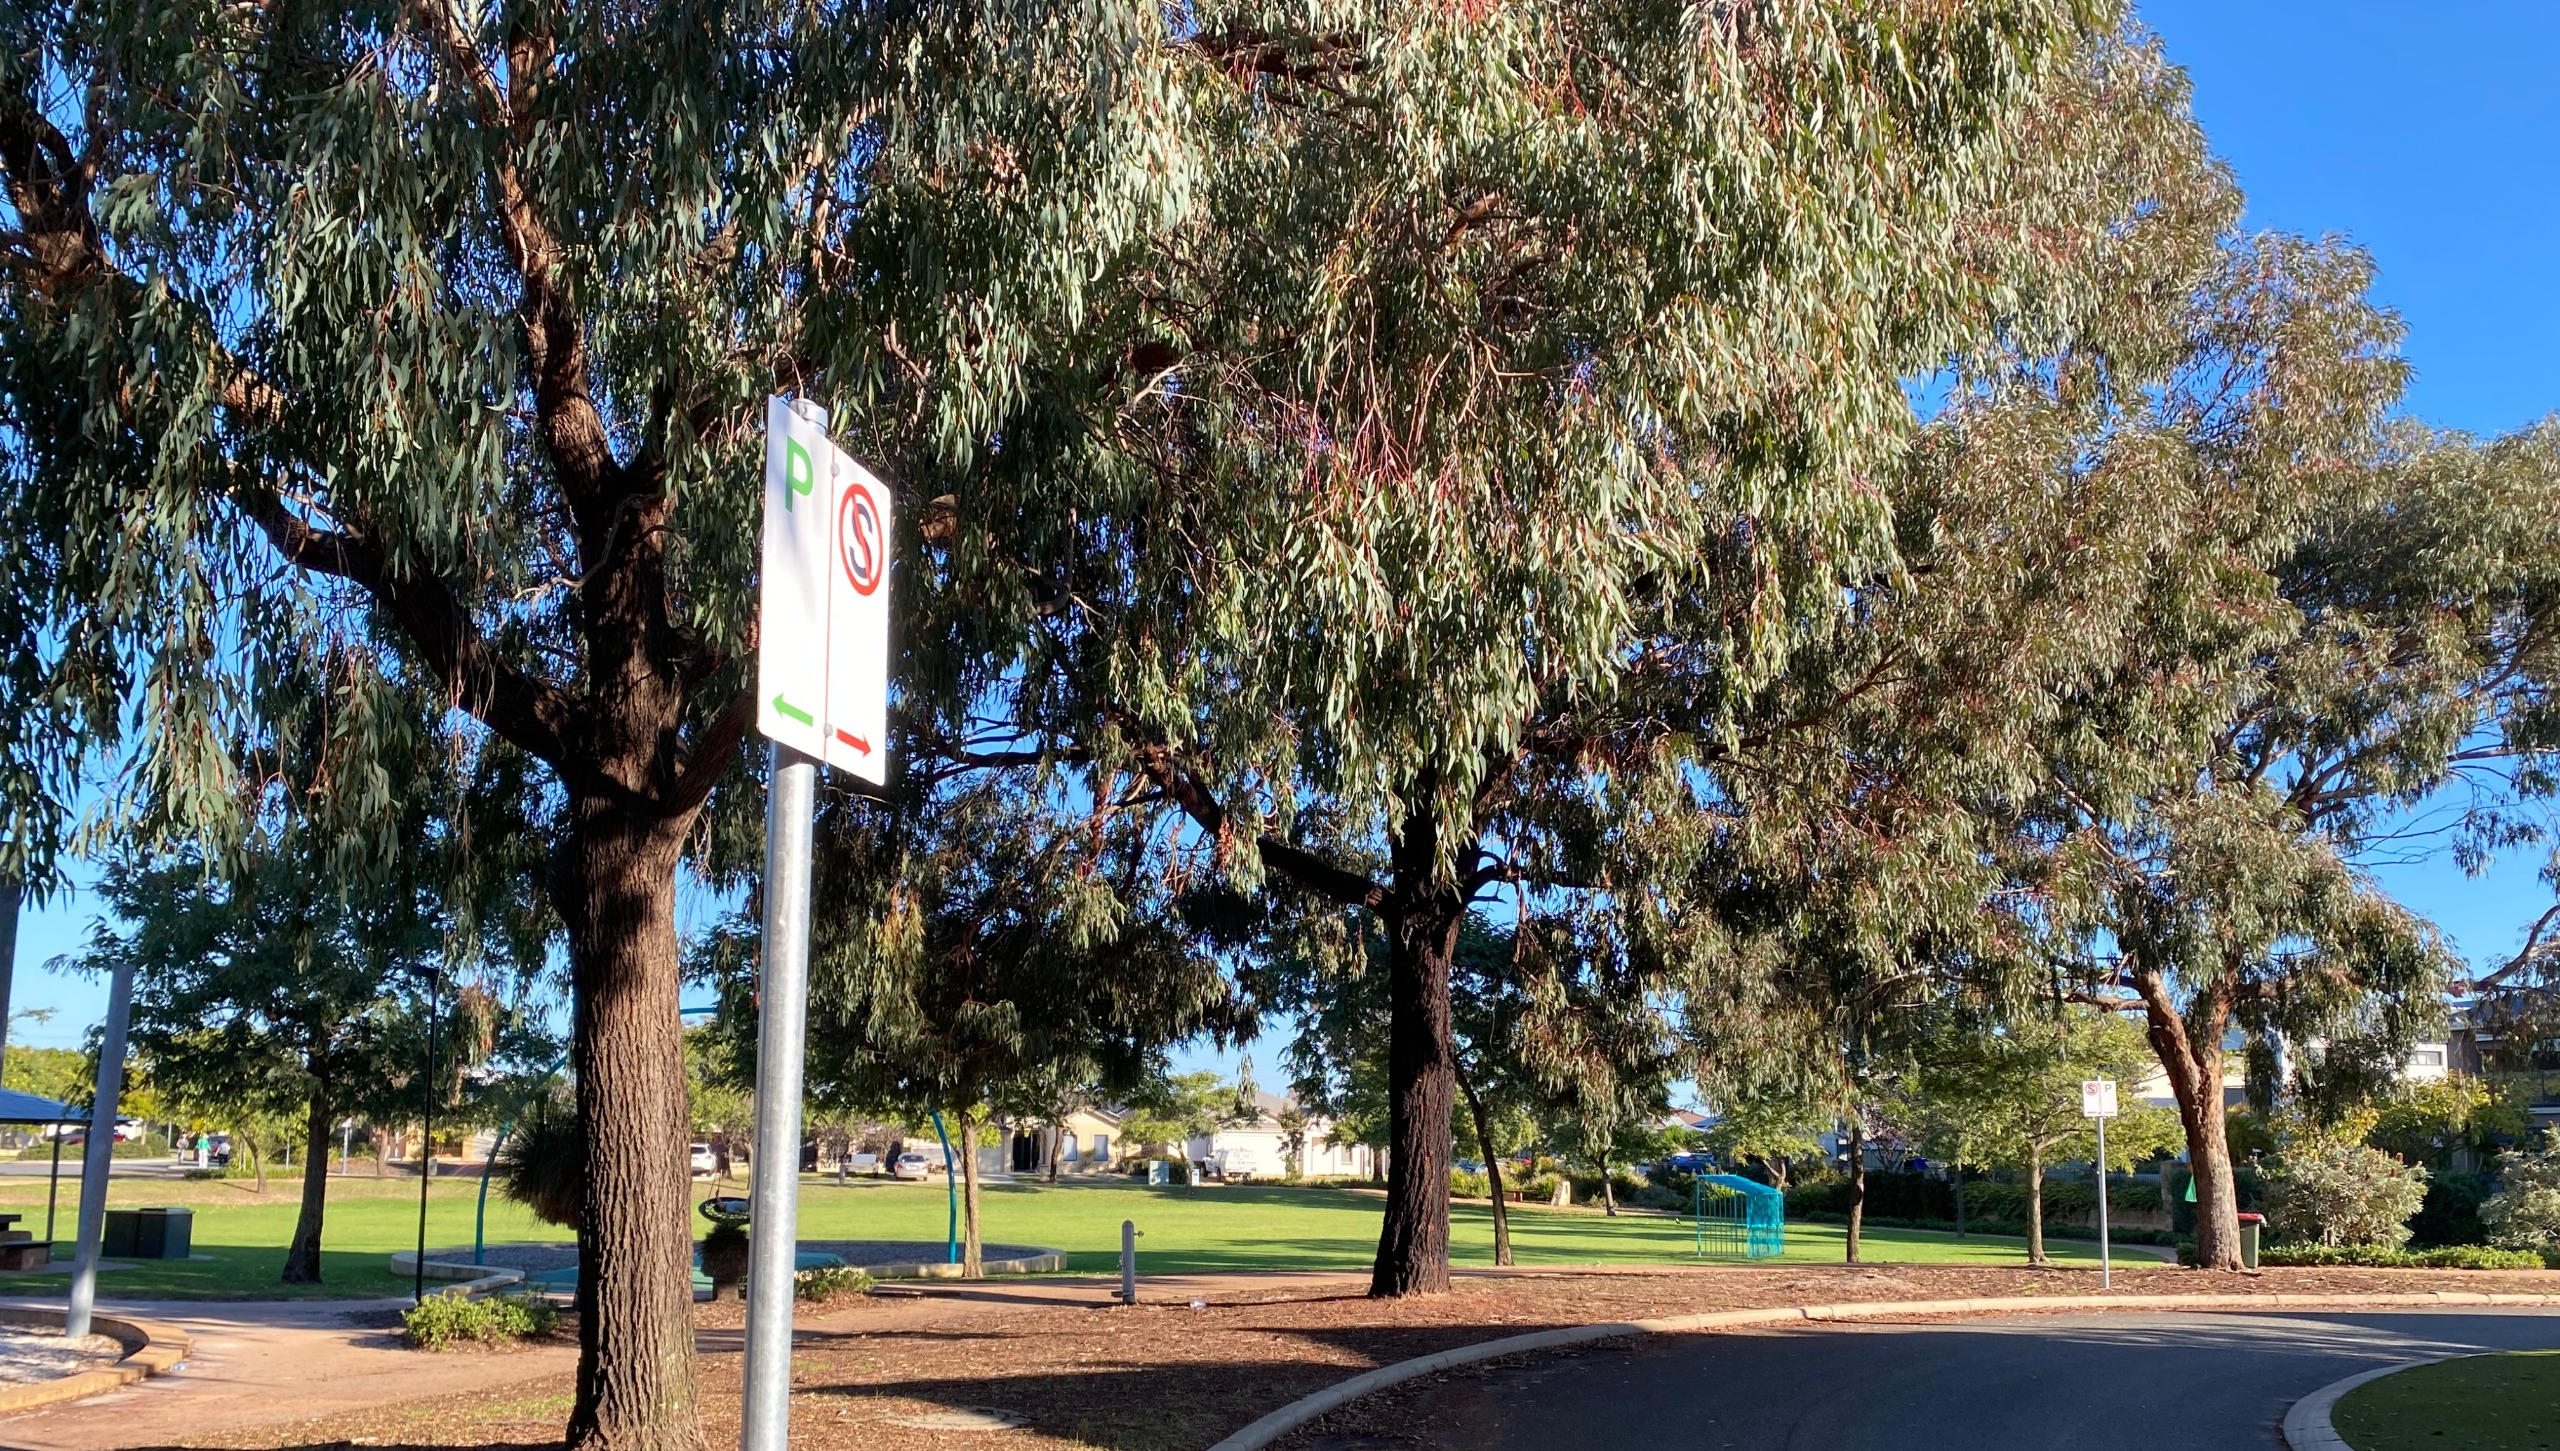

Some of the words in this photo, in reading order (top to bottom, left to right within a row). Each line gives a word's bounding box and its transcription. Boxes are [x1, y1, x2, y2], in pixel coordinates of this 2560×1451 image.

[785, 434, 813, 513] P
[849, 503, 873, 579] S
[2105, 1084, 2112, 1092] P
